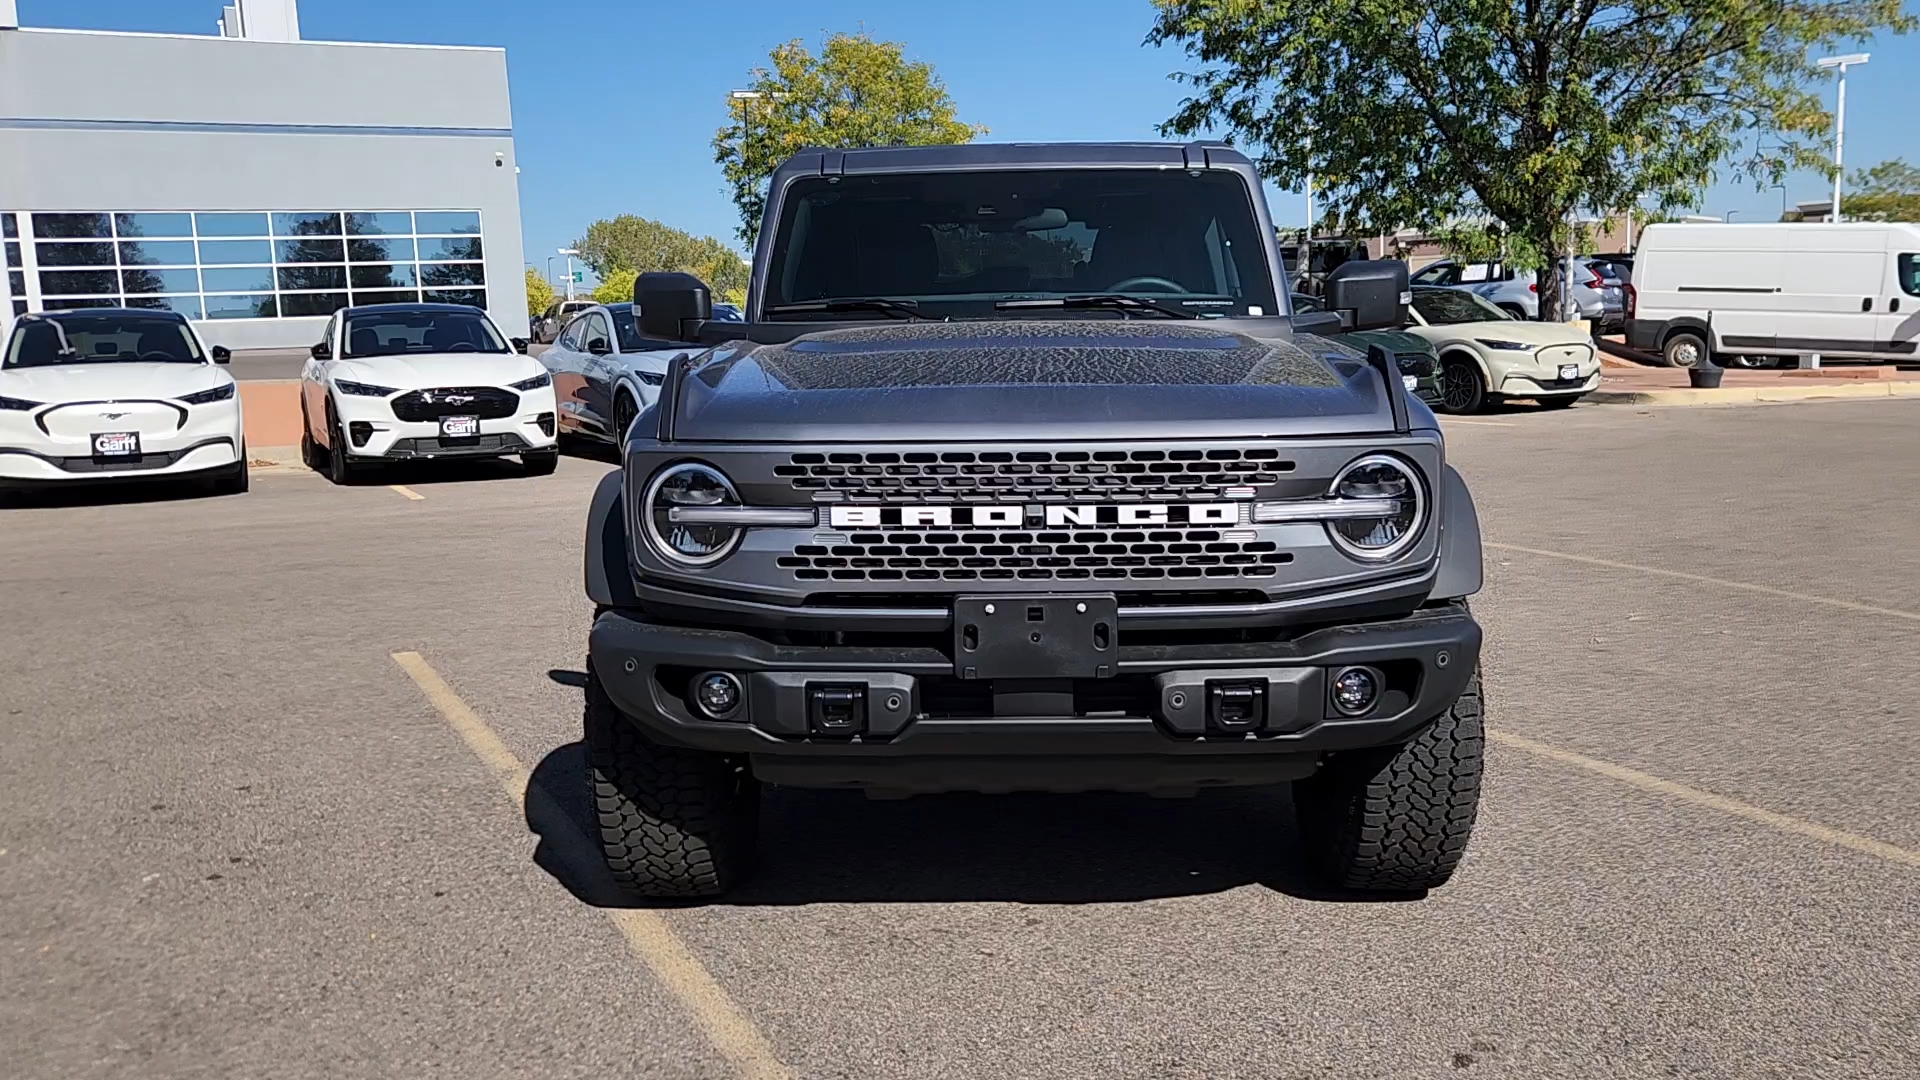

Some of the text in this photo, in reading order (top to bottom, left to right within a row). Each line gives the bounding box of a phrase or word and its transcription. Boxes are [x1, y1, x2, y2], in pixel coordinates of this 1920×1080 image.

[443, 419, 477, 434] Garff
[95, 436, 136, 451] Garff
[830, 503, 1239, 527] BRONCO
